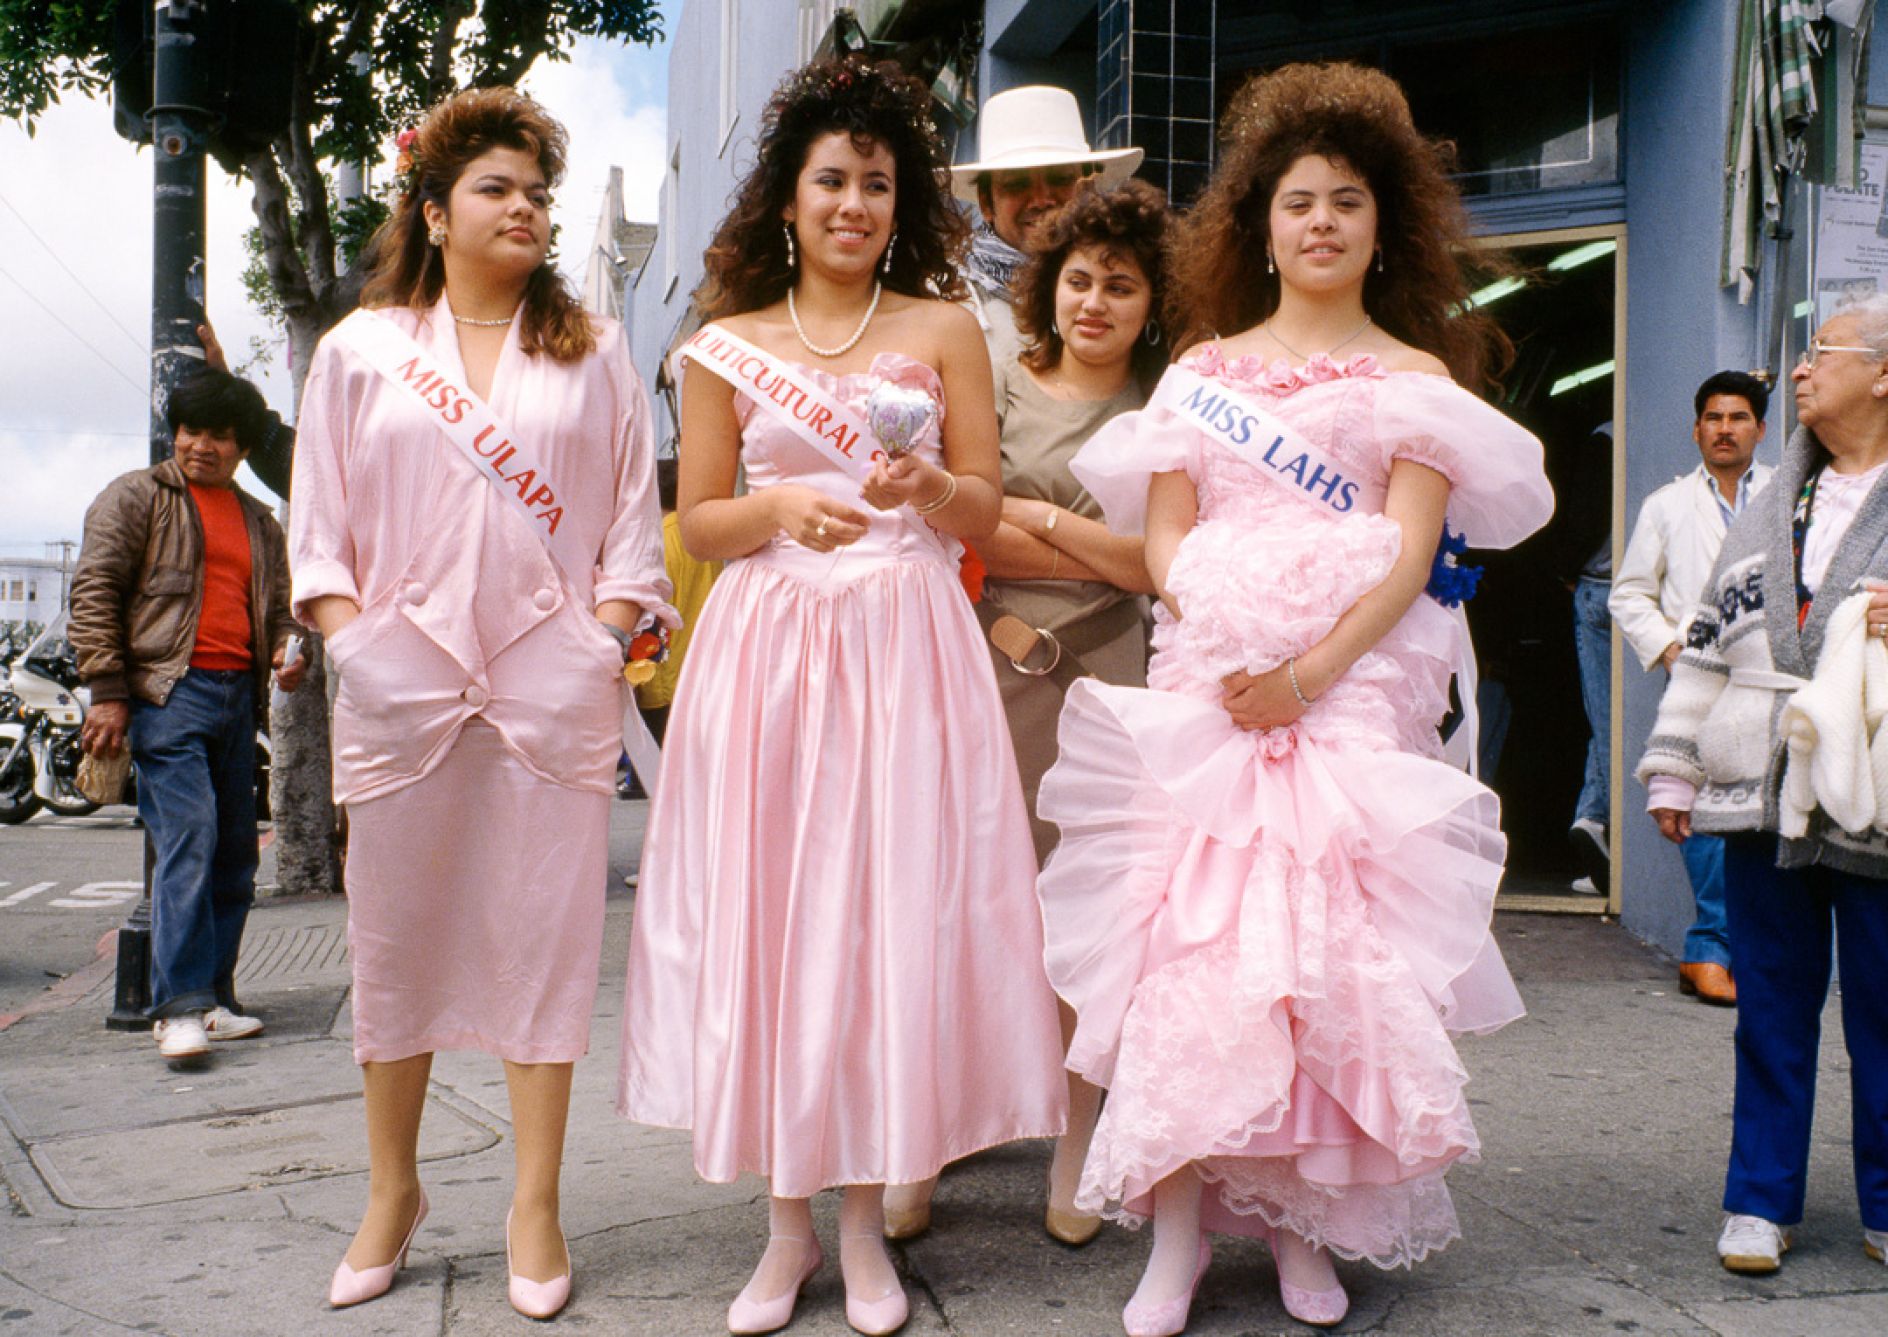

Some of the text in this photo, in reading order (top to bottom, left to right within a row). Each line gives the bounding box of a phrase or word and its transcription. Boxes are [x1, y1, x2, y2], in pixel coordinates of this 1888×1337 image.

[396, 357, 564, 536] MISS ULAPA
[687, 331, 860, 459] ULTICULTURAL
[1180, 386, 1360, 513] MISS LAHS
